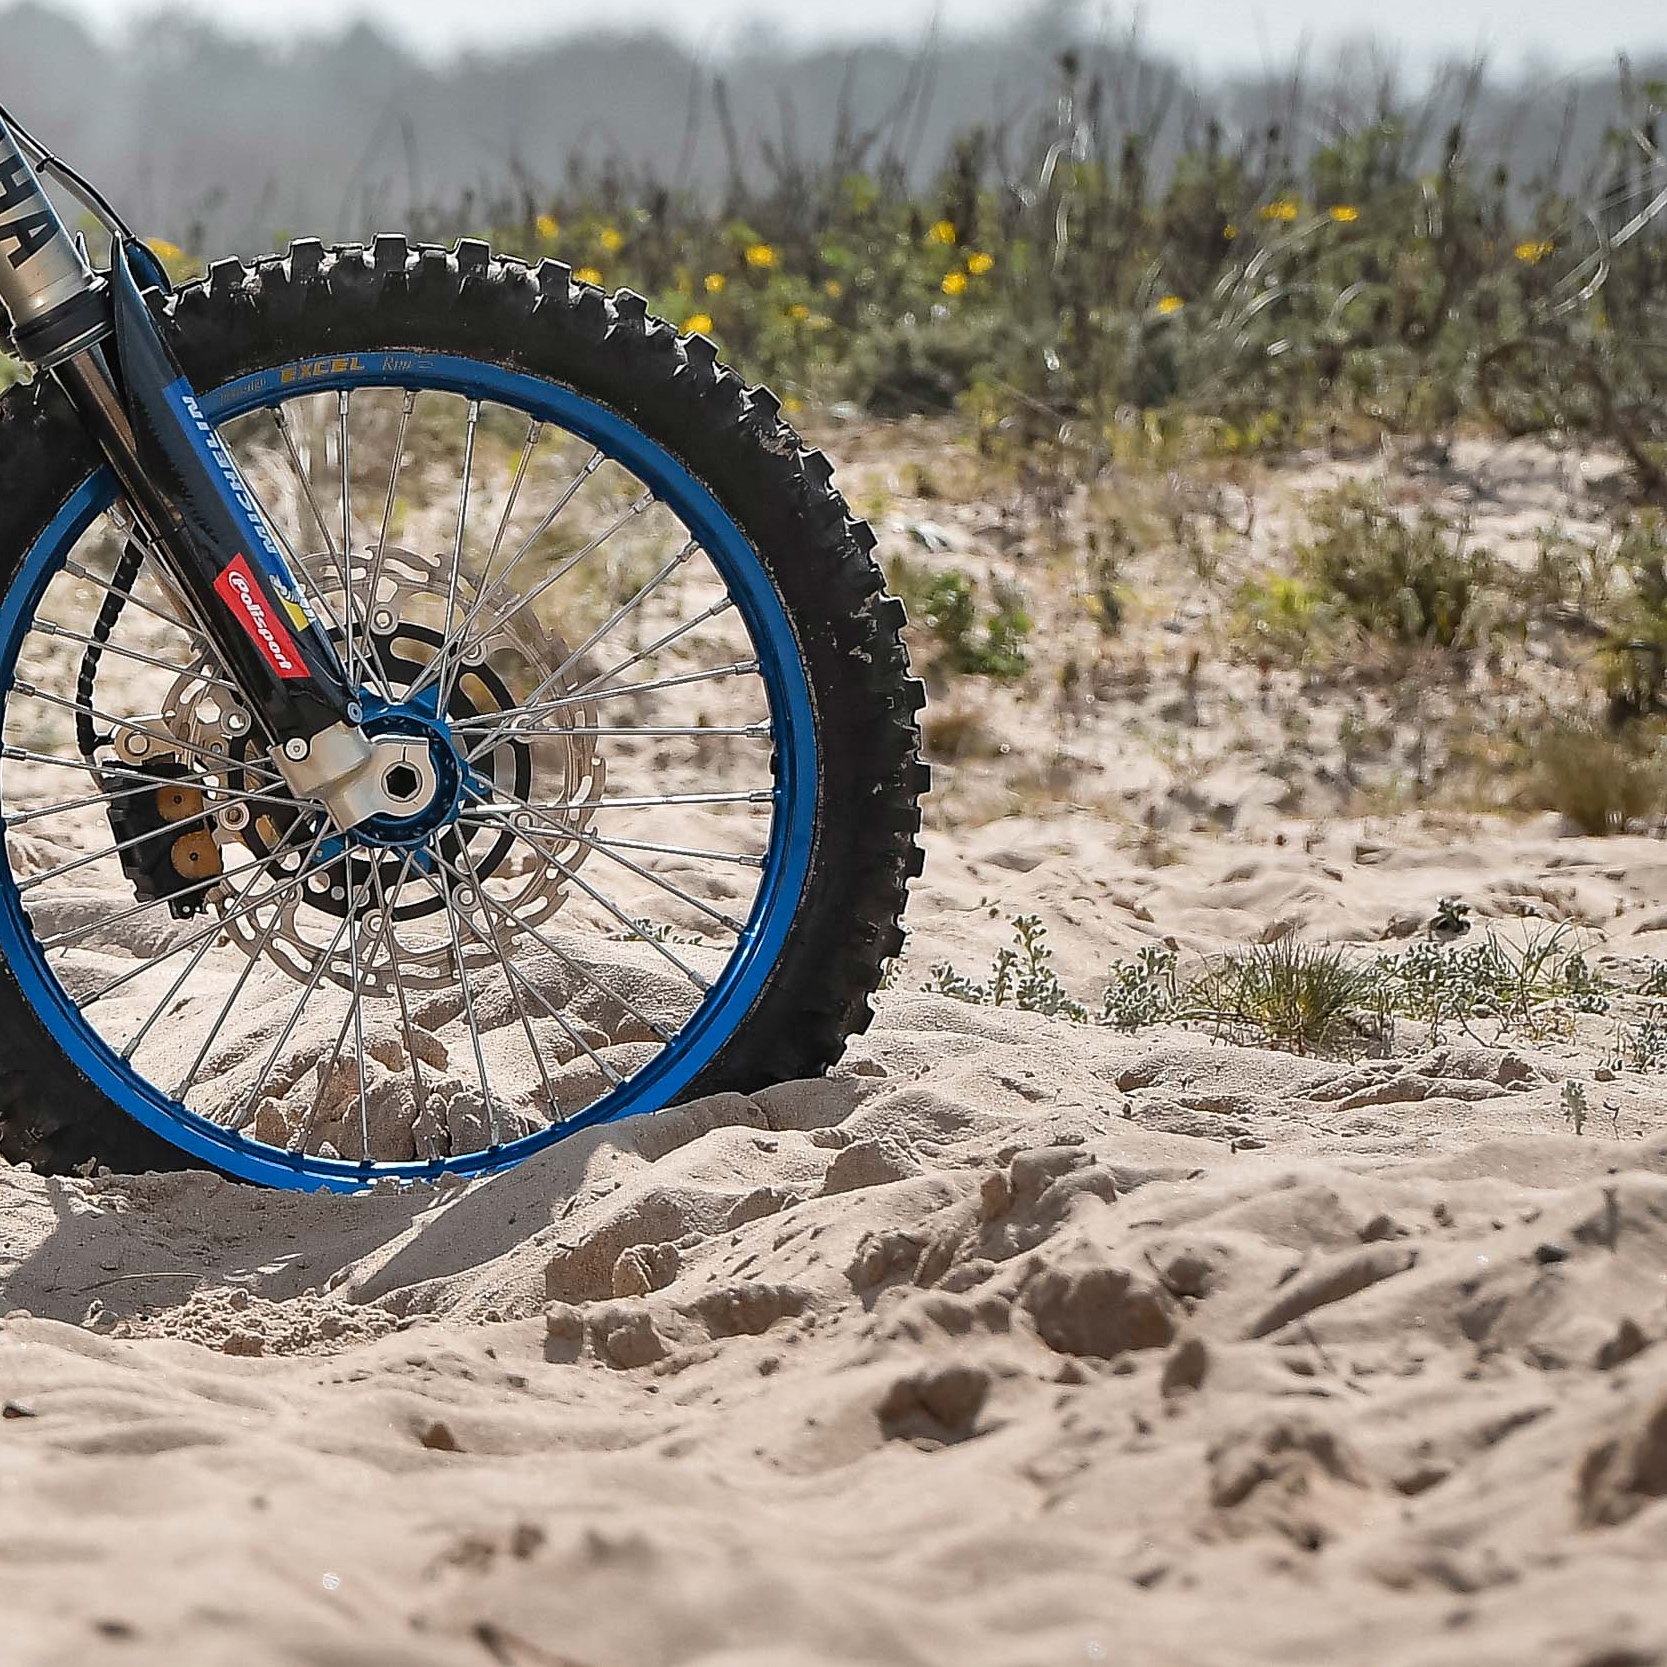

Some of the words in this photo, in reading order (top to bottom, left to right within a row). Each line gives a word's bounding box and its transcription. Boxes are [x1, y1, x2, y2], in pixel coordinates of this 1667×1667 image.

[279, 357, 365, 384] EXCEL
[182, 395, 278, 554] MICHELIN
[228, 570, 293, 672] Polisport
